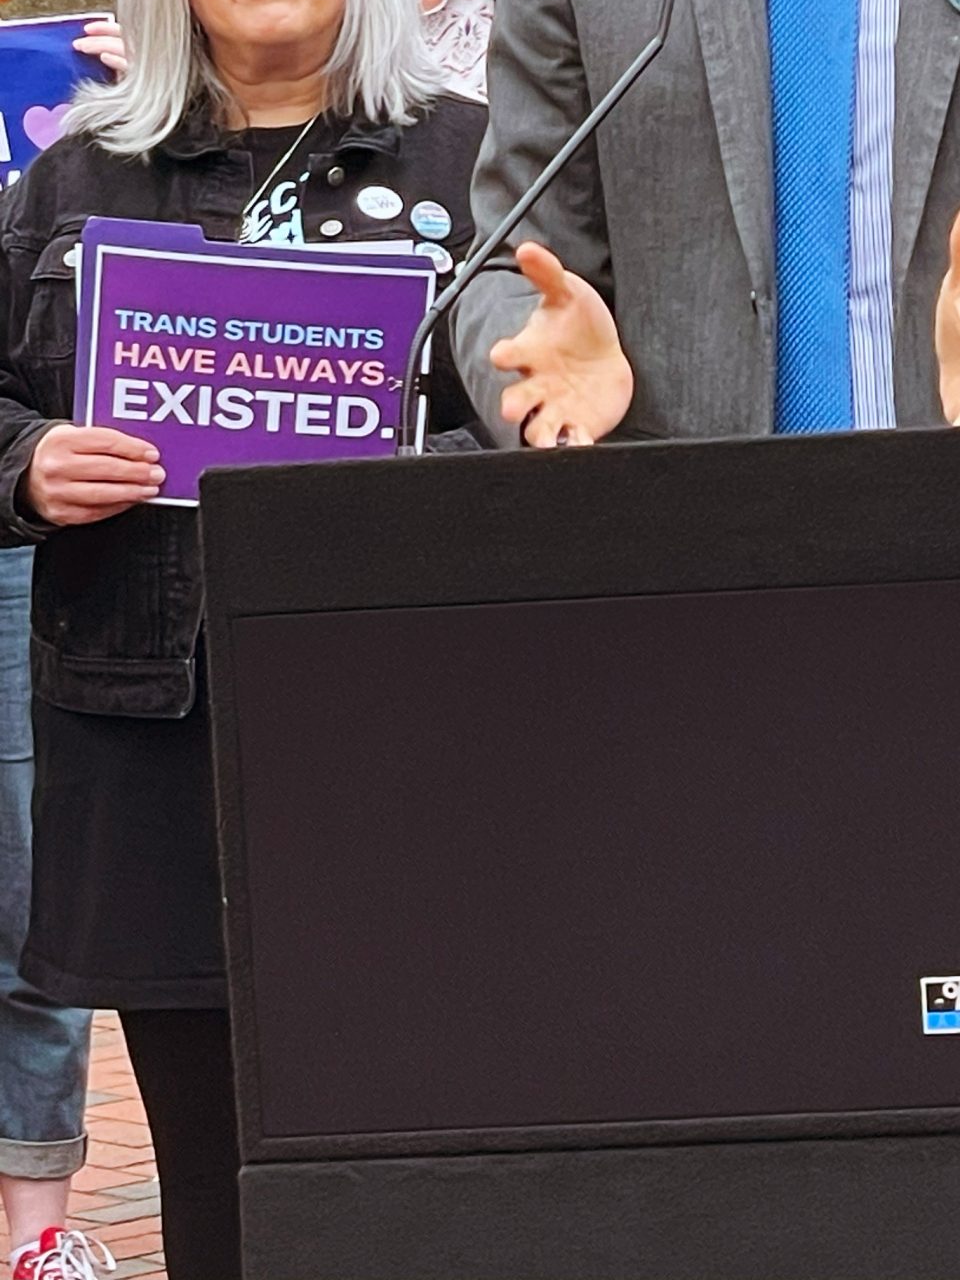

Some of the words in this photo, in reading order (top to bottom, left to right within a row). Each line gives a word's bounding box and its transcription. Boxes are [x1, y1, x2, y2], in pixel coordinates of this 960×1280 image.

[115, 309, 216, 338] TRANS
[225, 319, 384, 350] STUDENTS
[113, 341, 216, 374] HAVE
[225, 352, 385, 386] ALWAYS
[112, 378, 395, 439] EXISTED.
